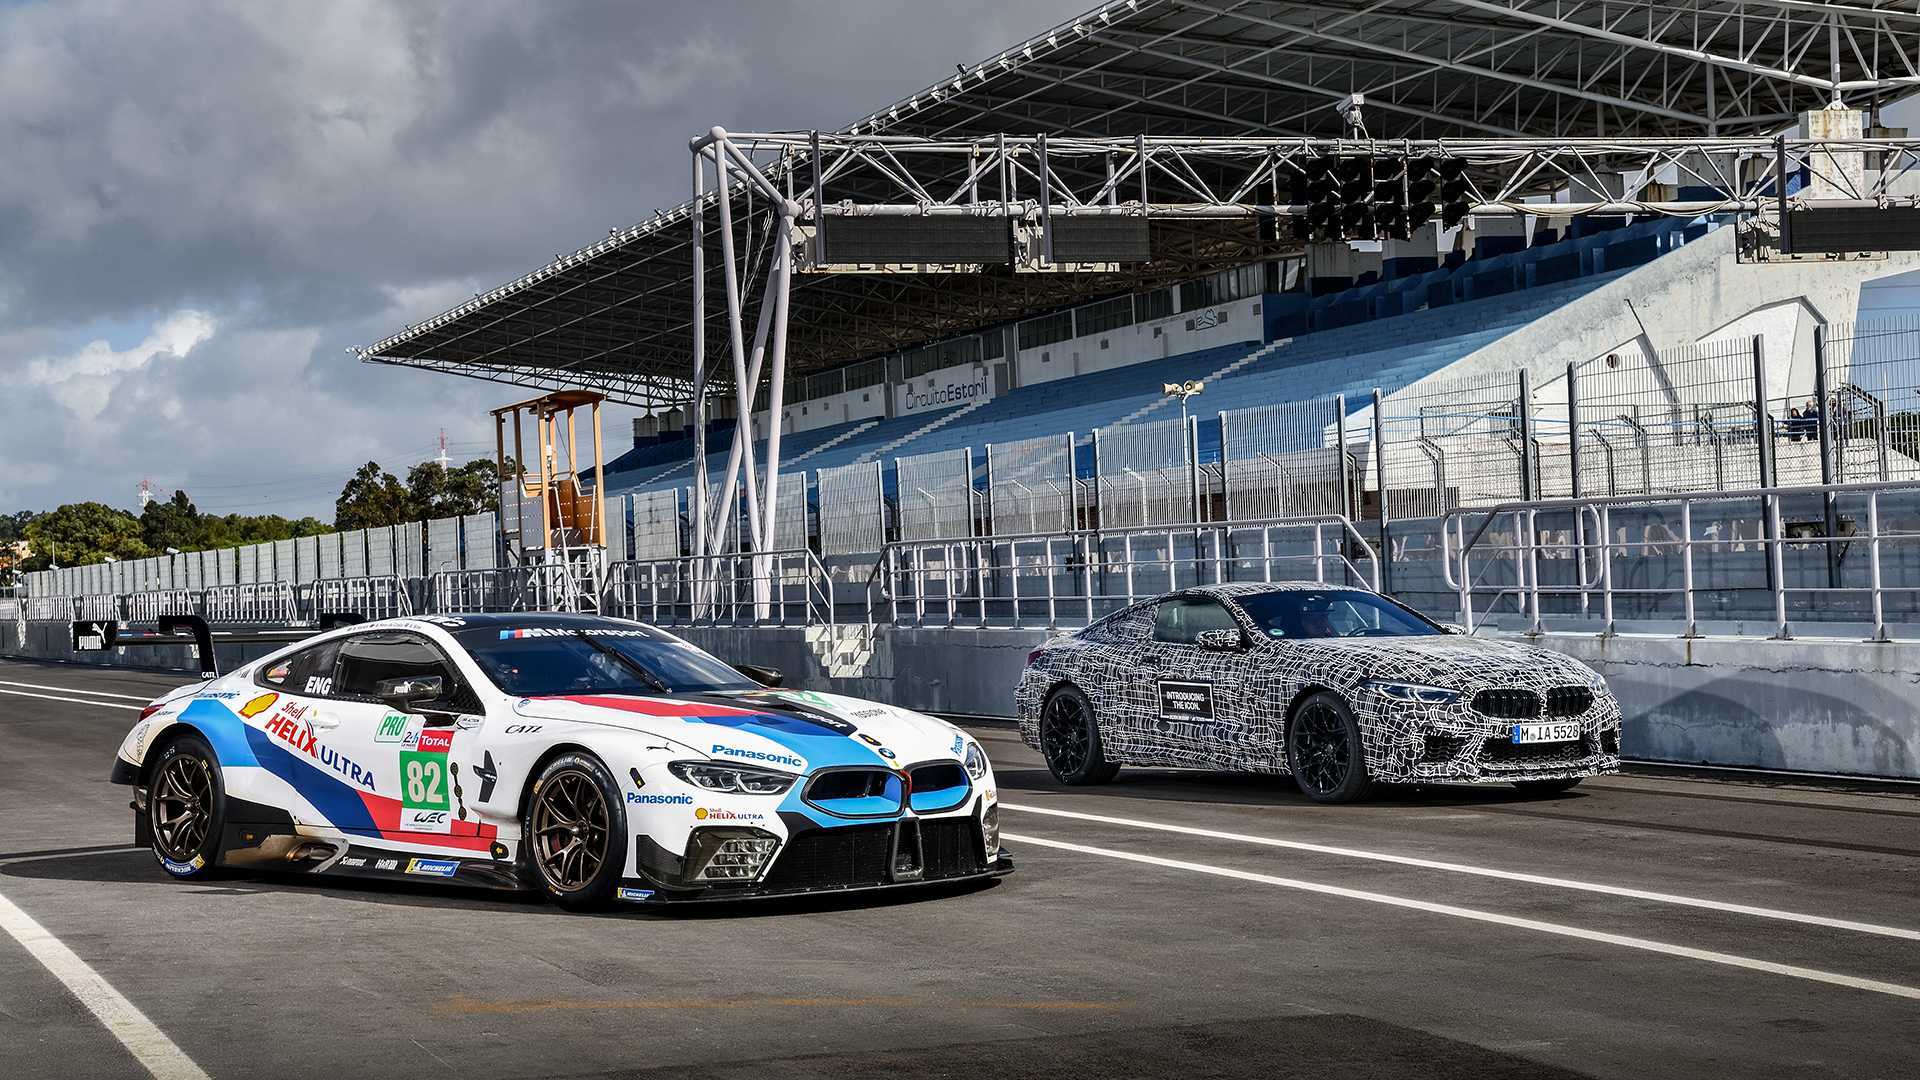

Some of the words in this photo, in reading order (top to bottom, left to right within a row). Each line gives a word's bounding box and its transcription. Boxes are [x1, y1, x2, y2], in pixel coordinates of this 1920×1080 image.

[906, 376, 988, 410] CircuitoEstoril
[78, 635, 102, 650] PUMA
[304, 676, 332, 696] ENG
[1166, 691, 1205, 702] INTRODUCING
[281, 700, 309, 720] Shell
[1172, 700, 1184, 710] THE
[379, 716, 408, 737] PRO
[505, 724, 543, 734] CATL
[1521, 727, 1529, 741] M
[1537, 726, 1551, 740] IA
[1553, 724, 1579, 740] 5528
[421, 735, 451, 747] TOTAL
[265, 712, 318, 759] HELIX
[321, 744, 376, 792] ULTRA
[711, 744, 802, 767] Panasonic
[407, 760, 443, 803] 82
[626, 792, 693, 805] Panasonic
[413, 812, 447, 824] WEC
[709, 811, 736, 820] HELIX
[421, 863, 454, 872] MICHELIN
